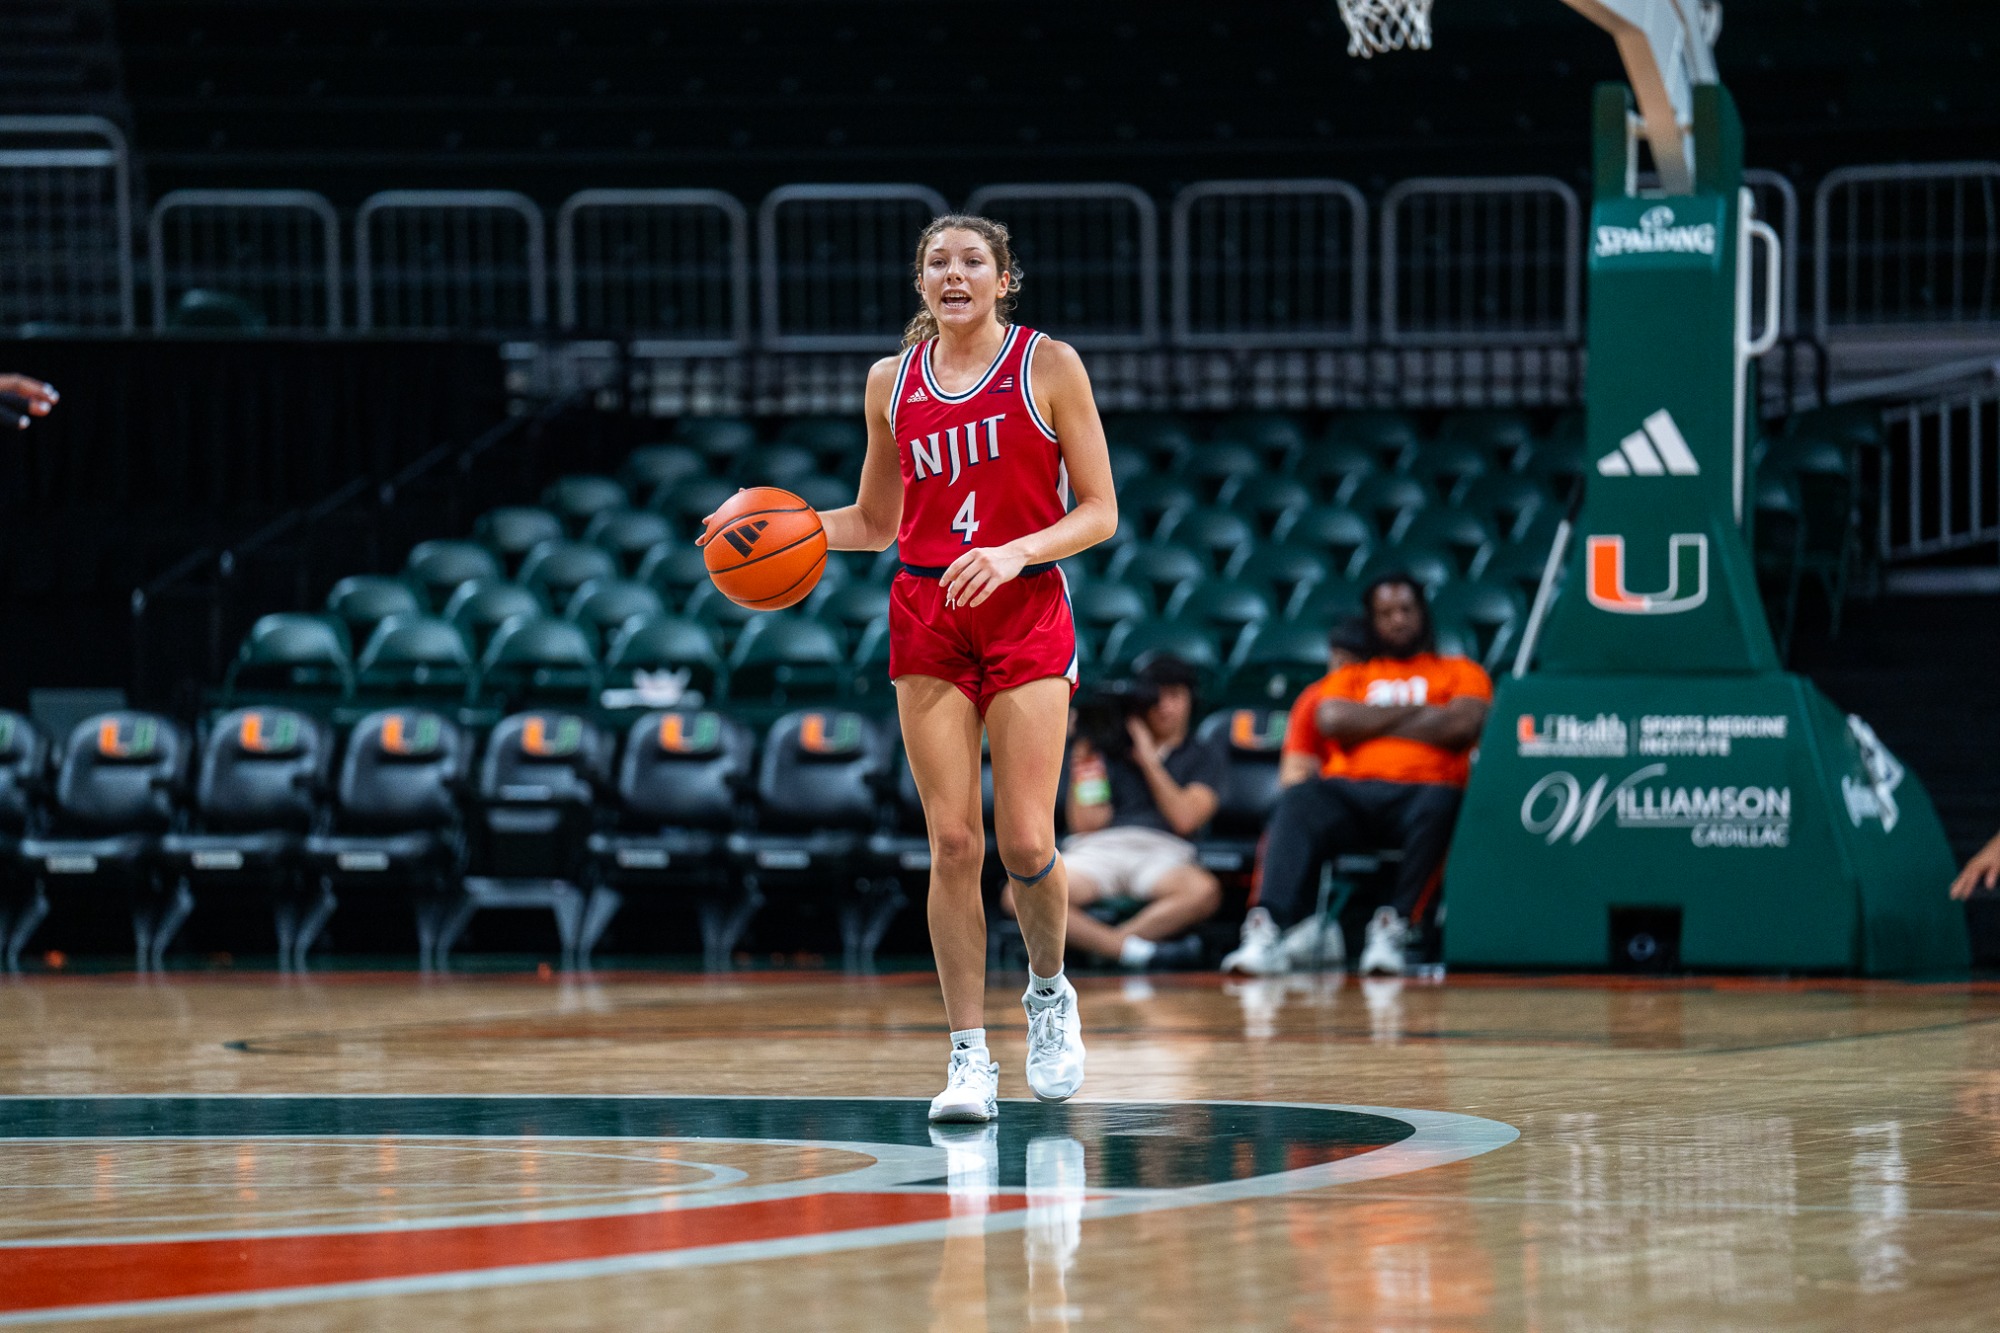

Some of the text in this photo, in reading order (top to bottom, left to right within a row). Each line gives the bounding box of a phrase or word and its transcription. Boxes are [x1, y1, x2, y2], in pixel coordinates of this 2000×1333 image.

[1595, 222, 1715, 257] SPALDING
[907, 394, 928, 403] adidas
[909, 413, 1006, 487] NJIT
[951, 491, 980, 545] 4
[1586, 533, 1708, 614] U
[1640, 715, 1788, 738] SPORTS MEDICINE
[1639, 736, 1730, 756] INSTITUTE
[1520, 763, 1790, 845] WILLIAMSON
[1691, 824, 1790, 848] CADILLAC
